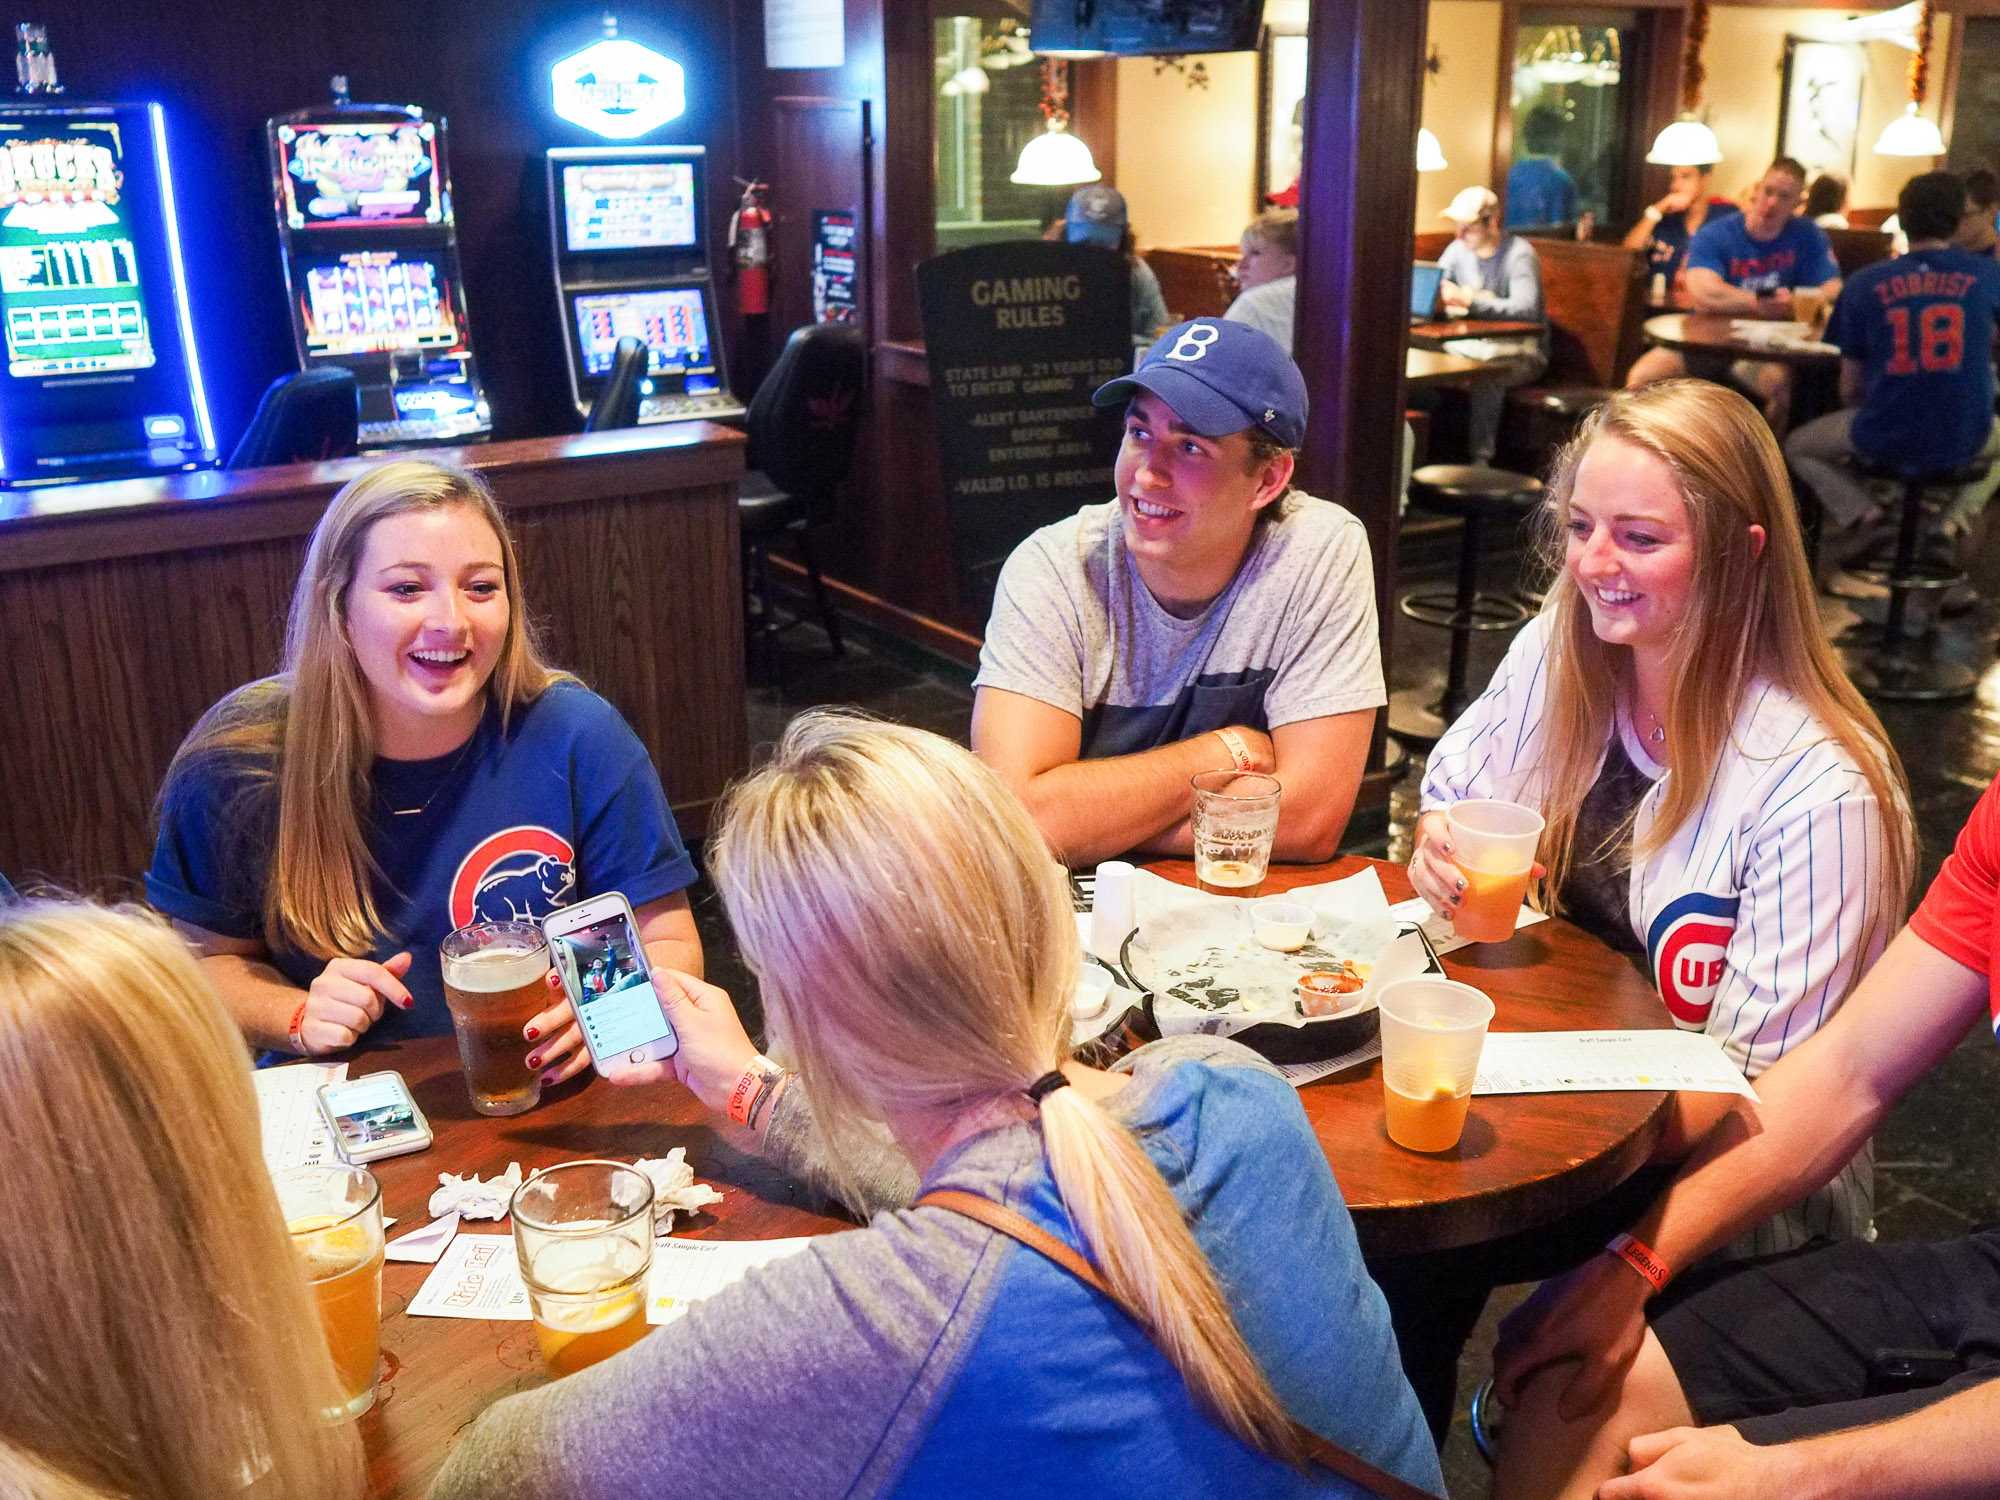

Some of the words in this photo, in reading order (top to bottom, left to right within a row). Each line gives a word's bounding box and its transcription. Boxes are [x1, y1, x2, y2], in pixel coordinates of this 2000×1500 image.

[971, 276, 1081, 305] GAMING
[995, 305, 1066, 329] RULES
[1165, 324, 1219, 361] B
[1887, 304, 1965, 374] 18
[949, 382, 968, 397] TO
[1036, 472, 1050, 489] IS
[731, 1071, 754, 1113] EGENDS
